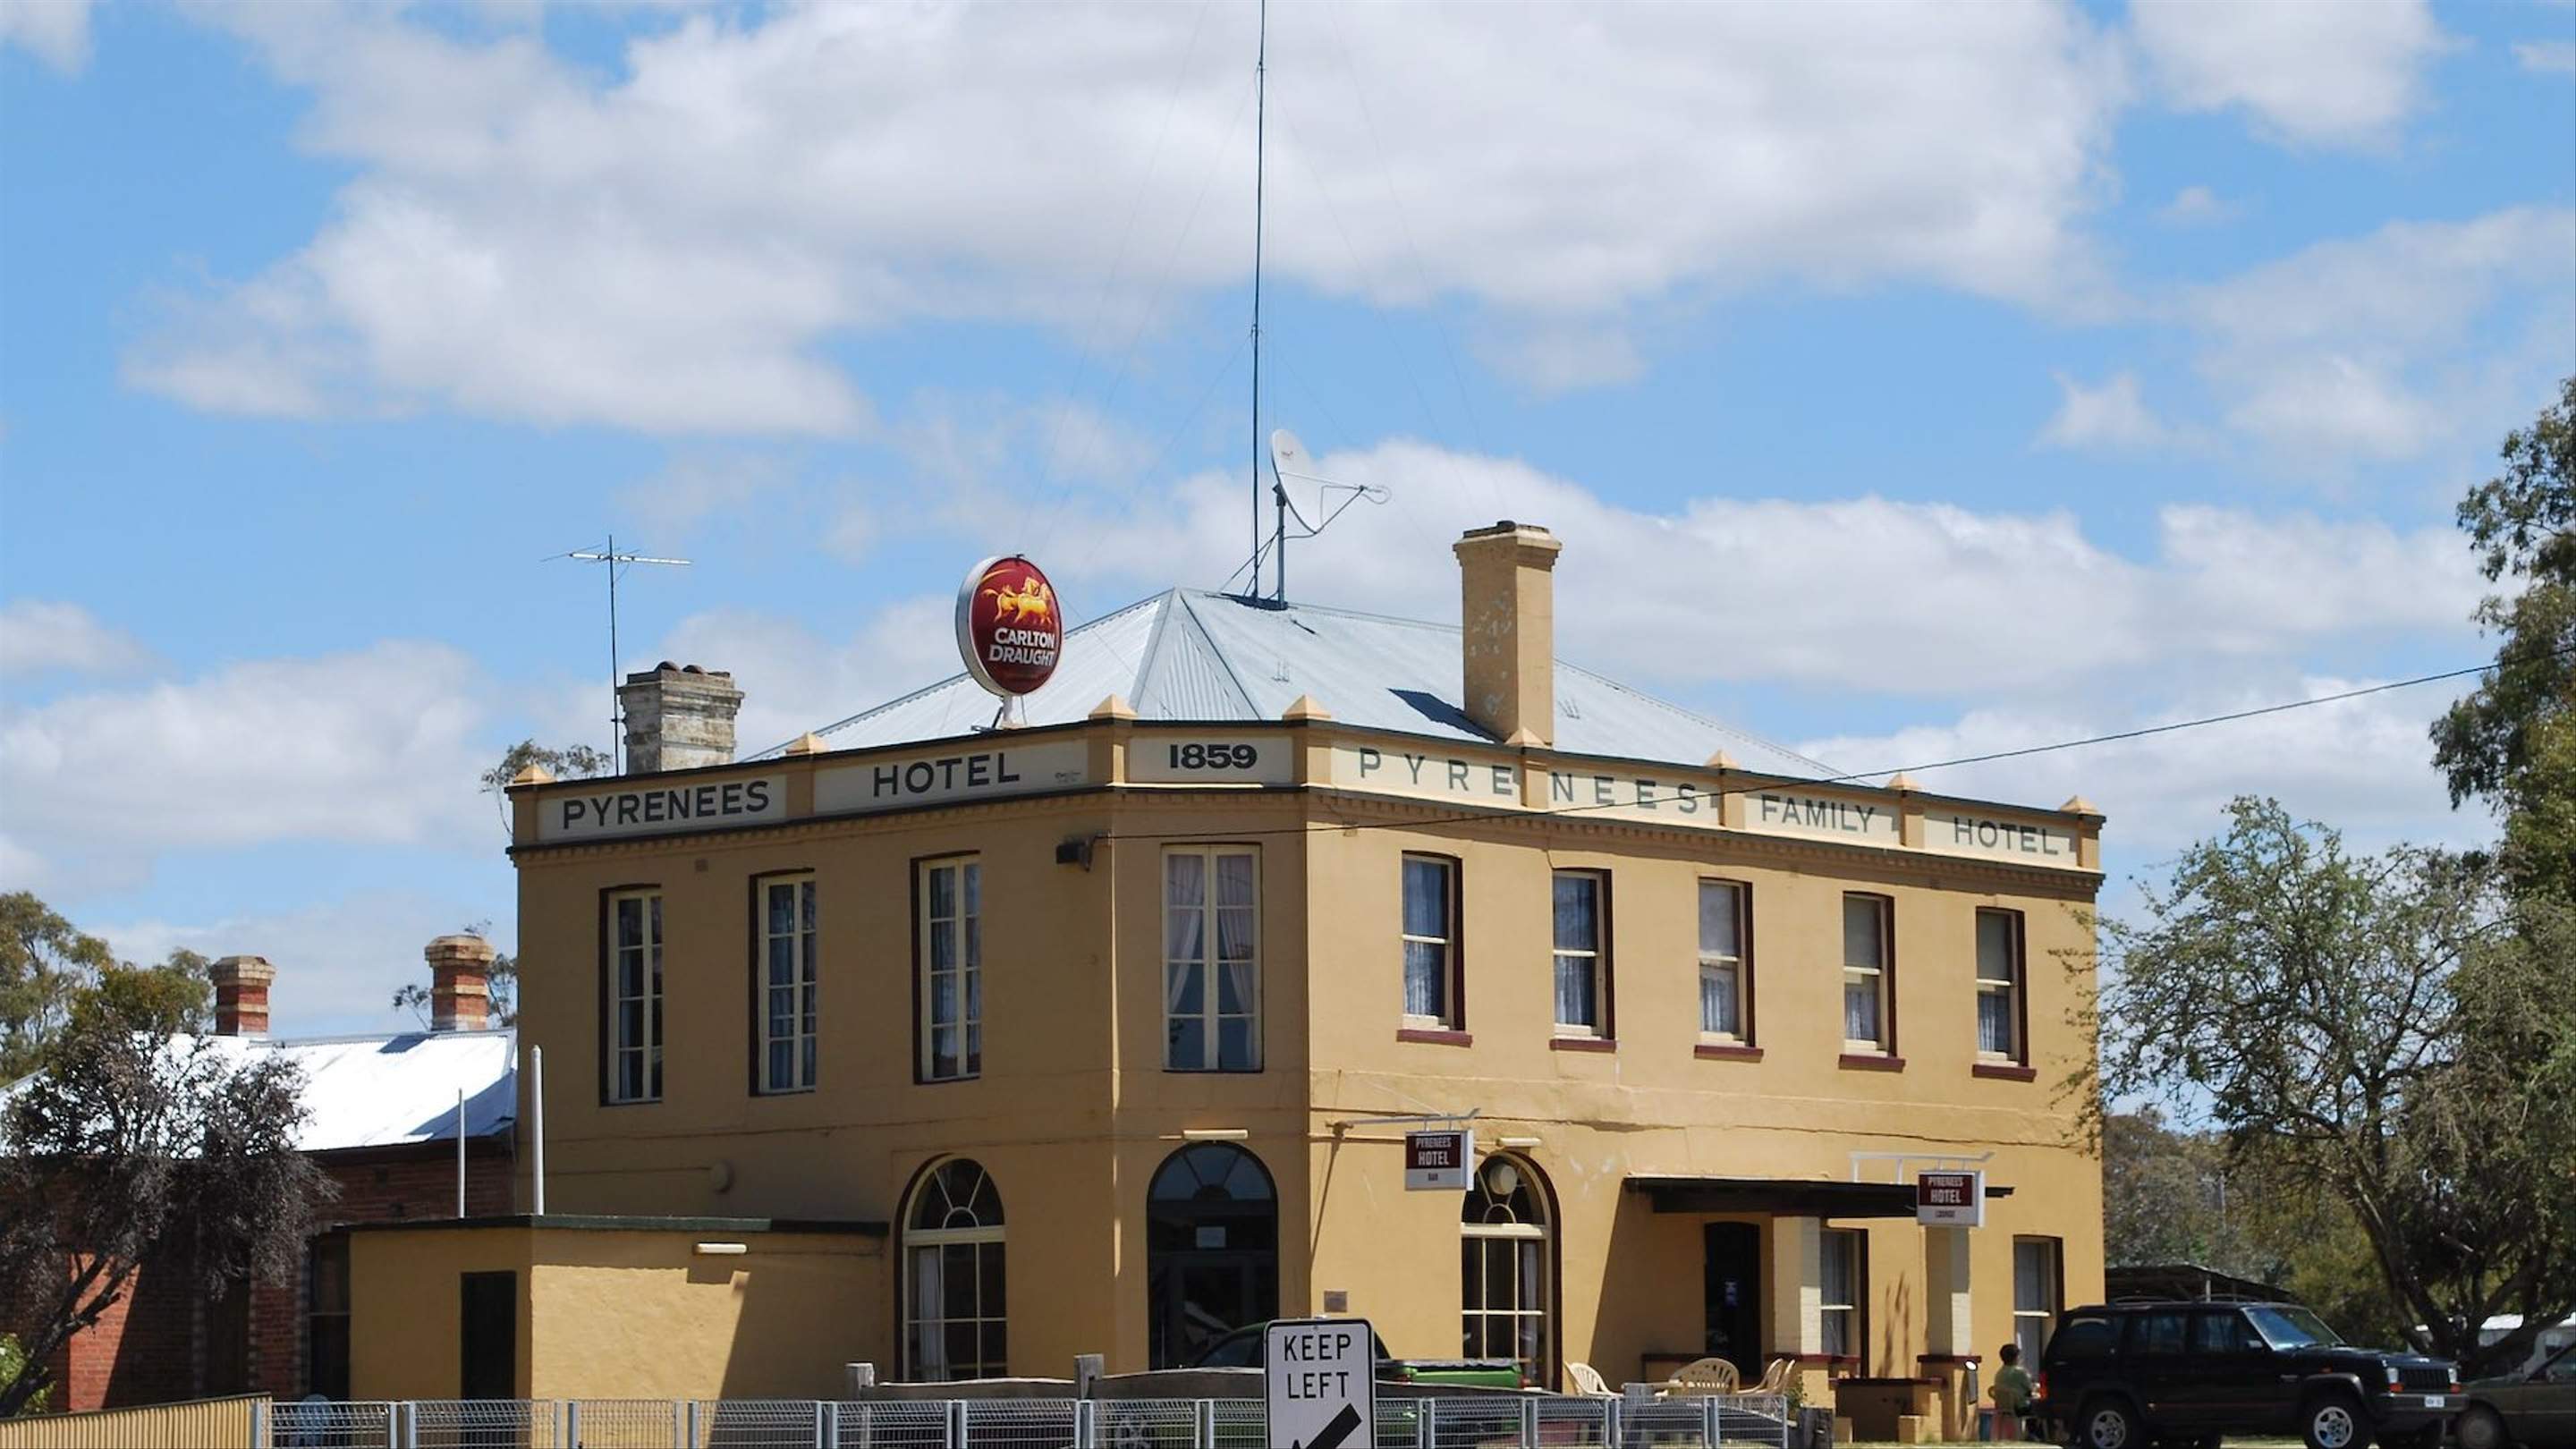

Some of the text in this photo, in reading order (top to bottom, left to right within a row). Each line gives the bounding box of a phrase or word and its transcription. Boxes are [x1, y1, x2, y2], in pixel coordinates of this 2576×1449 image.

[994, 627, 1055, 649] CARLTON
[988, 643, 1055, 666] DRAUGHT
[1169, 743, 1258, 770] 1859
[563, 752, 1020, 830] PYRENEES HOTEL
[1760, 794, 1876, 834] FAMILY
[1953, 816, 2059, 856] HOTEL
[1418, 1150, 1450, 1166] HOTEL
[1930, 1189, 1962, 1204] HOTEL
[1284, 1334, 1352, 1361] KEEP
[1287, 1372, 1349, 1399] LEFT
